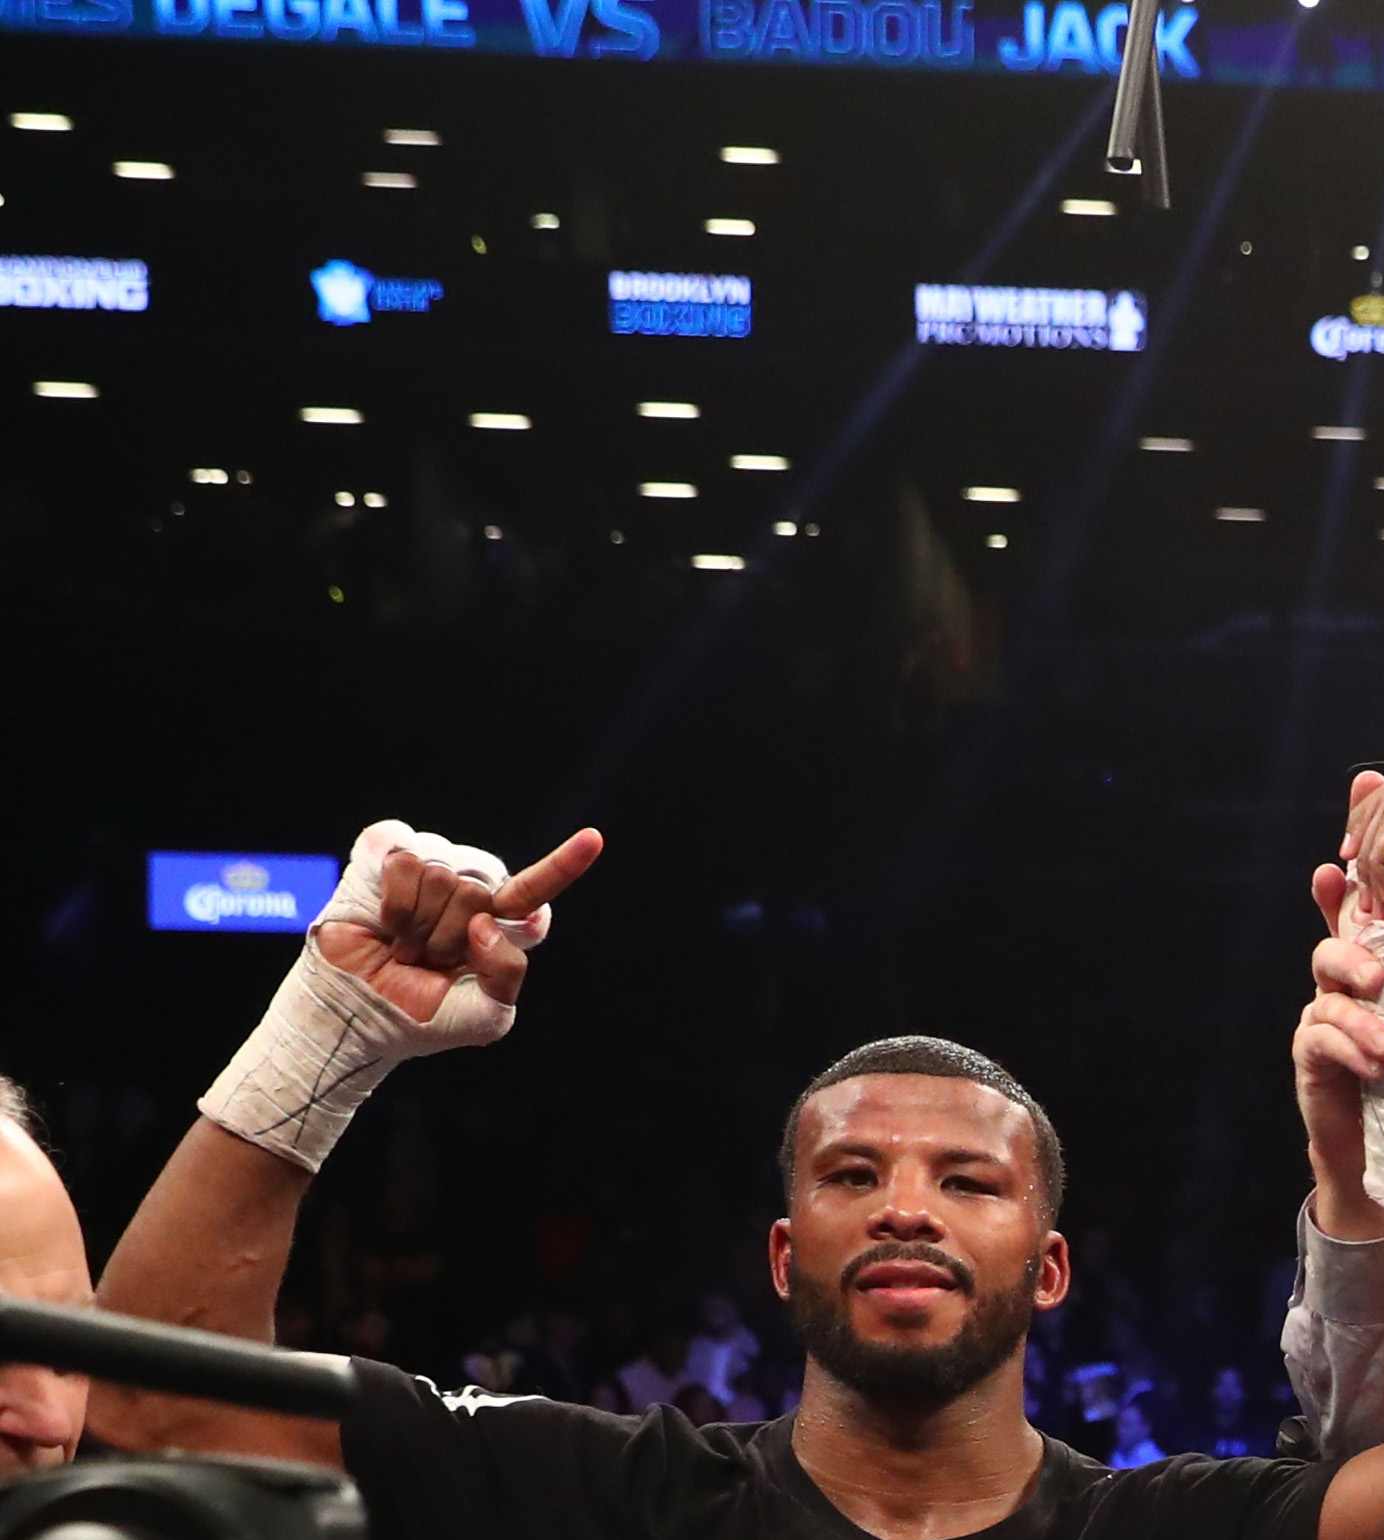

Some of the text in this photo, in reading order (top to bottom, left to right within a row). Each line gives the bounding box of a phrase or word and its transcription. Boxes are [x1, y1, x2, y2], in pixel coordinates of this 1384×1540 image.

[524, 0, 660, 61] VS
[705, 0, 974, 66] BADOU
[1000, 0, 1200, 78] JACK
[0, 278, 148, 311] OXING
[609, 271, 752, 302] BROOKLYN
[183, 882, 297, 924] Corona
